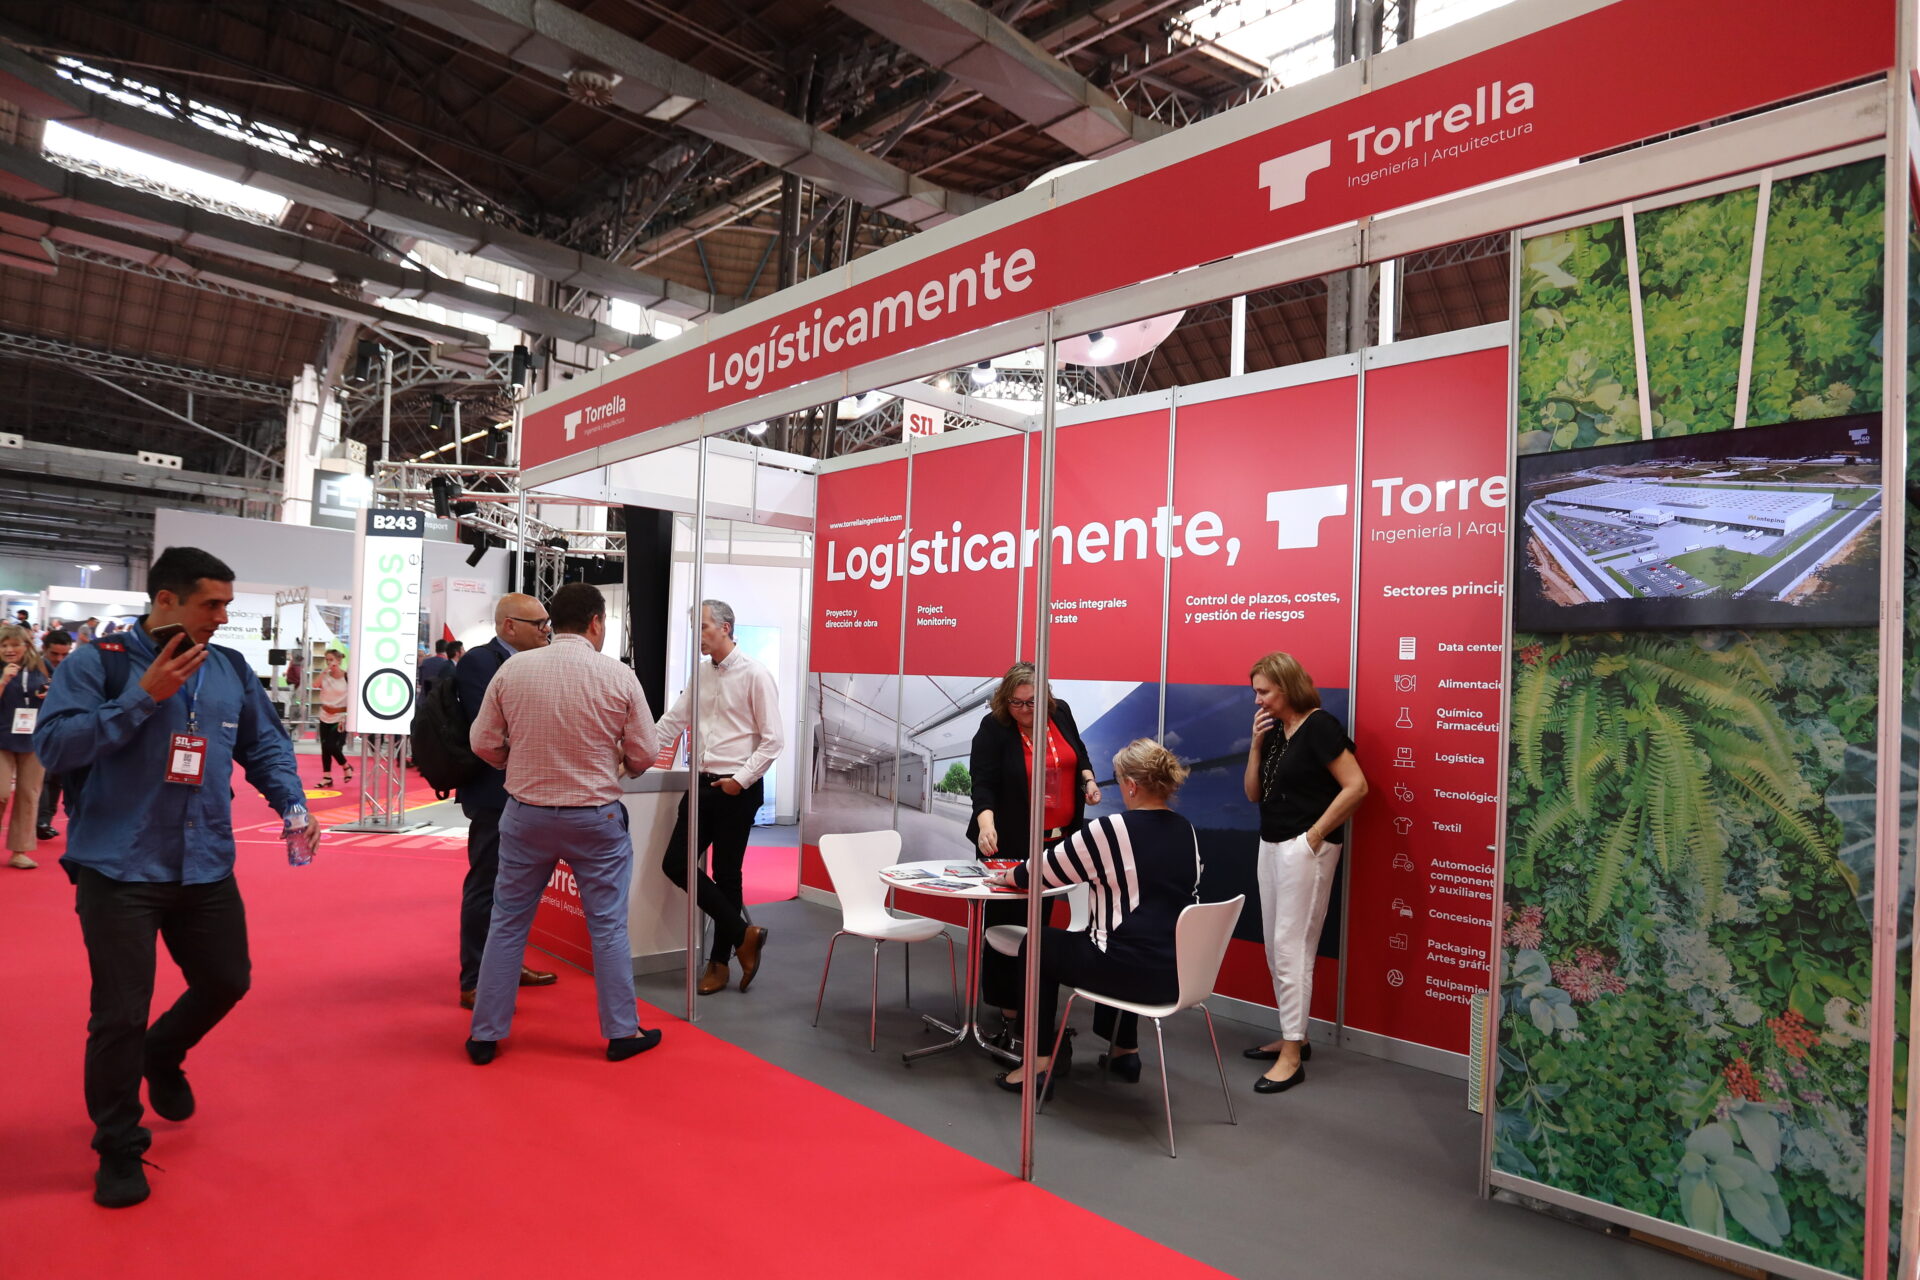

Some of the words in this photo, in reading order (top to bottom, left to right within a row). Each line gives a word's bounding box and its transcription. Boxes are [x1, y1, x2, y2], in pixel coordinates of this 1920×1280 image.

[1347, 80, 1534, 164] Torrella
[1347, 156, 1419, 188] Ingeniería
[1431, 122, 1533, 163] Arquitectura
[707, 248, 1036, 393] Logísticamente
[584, 395, 626, 424] Torrella
[1371, 475, 1507, 517] Torre
[373, 515, 417, 531] B243
[424, 521, 449, 531] nsport
[1371, 522, 1452, 544] Ingeniería
[1466, 520, 1506, 537] Arqu
[826, 505, 1241, 590] Logísticamente,
[1383, 584, 1448, 598] Sectores
[1452, 580, 1505, 598] princip
[1050, 599, 1078, 610] vicios
[1079, 597, 1127, 611] integrales
[1185, 593, 1228, 606] Control
[1230, 593, 1246, 605] de
[1248, 592, 1291, 606] plazos,
[1294, 591, 1340, 604] costes,
[825, 608, 852, 619] Proyecto
[853, 608, 858, 618] y
[917, 605, 943, 616] Project
[1184, 612, 1193, 624] y
[1194, 608, 1238, 623] gestión
[1240, 608, 1256, 621] de
[1259, 607, 1305, 622] riesgos
[825, 619, 853, 629] dirección
[853, 619, 862, 628] de
[863, 619, 878, 628] obra
[916, 616, 957, 628] Monitoring
[1054, 614, 1078, 624] state
[1438, 642, 1464, 652] Data
[1466, 643, 1503, 652] center
[1437, 678, 1504, 690] Alimentació
[1436, 707, 1483, 719] Químico
[1436, 720, 1501, 733] Farmacéuti
[1435, 752, 1485, 765] Logística
[1432, 821, 1462, 833] Textil
[1430, 872, 1495, 888] component
[1429, 884, 1437, 894] y
[1438, 886, 1492, 901] auxiliares
[1428, 908, 1493, 928] Concesiona
[1427, 938, 1486, 960] Packaging
[1426, 951, 1456, 965] Artes
[1458, 959, 1491, 972] gráfic
[1425, 975, 1489, 994] Equipamie
[1425, 988, 1472, 1006] deportiv
